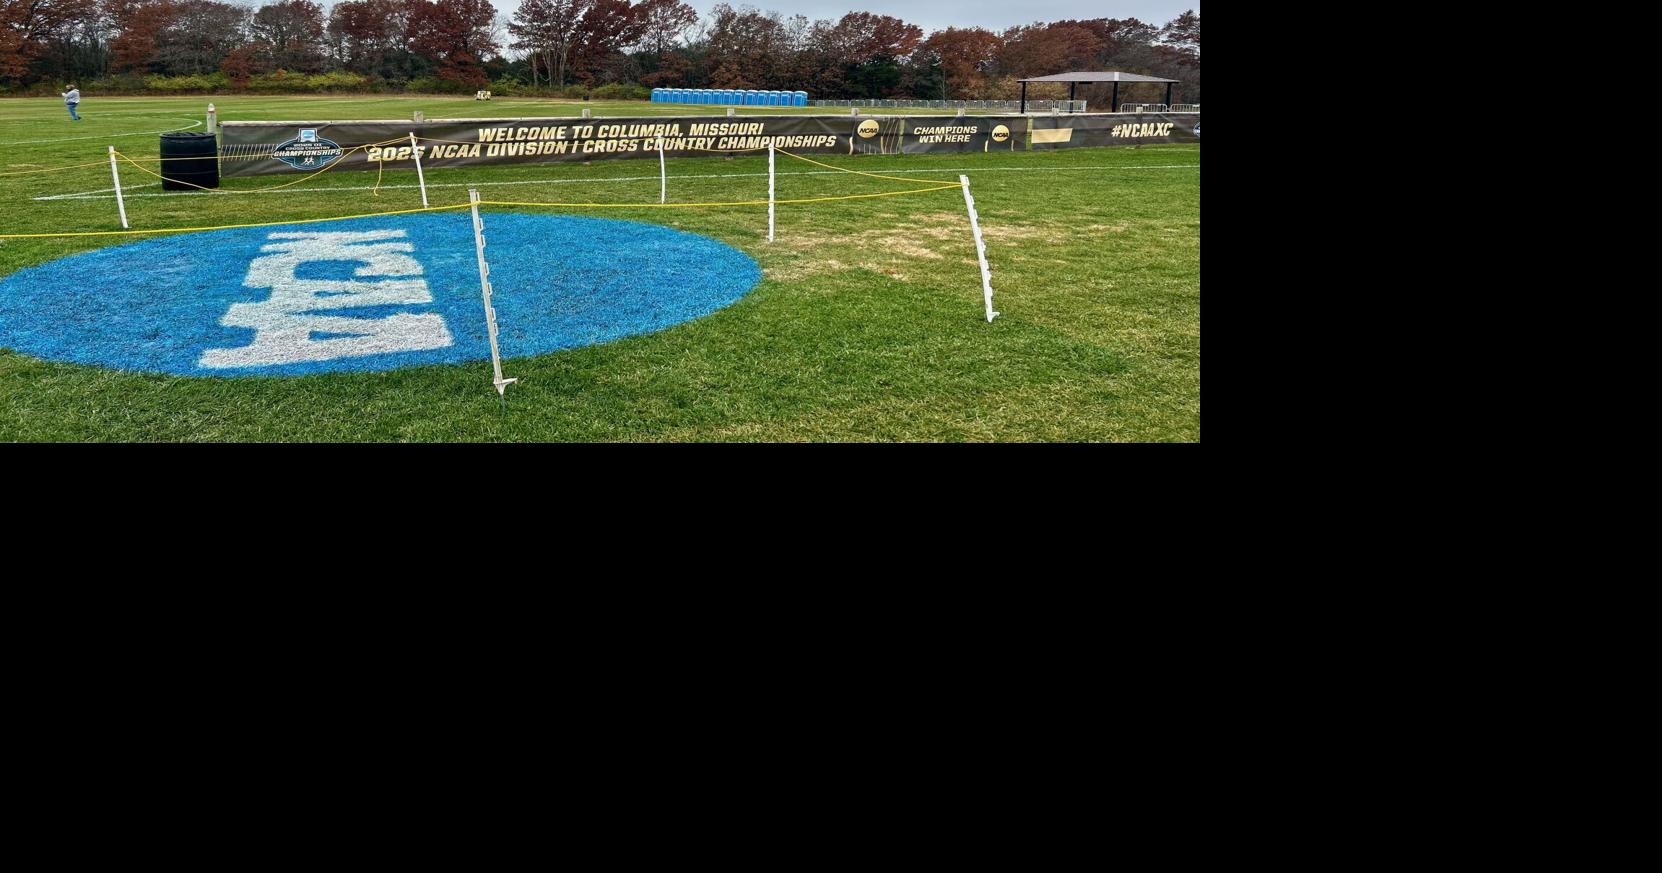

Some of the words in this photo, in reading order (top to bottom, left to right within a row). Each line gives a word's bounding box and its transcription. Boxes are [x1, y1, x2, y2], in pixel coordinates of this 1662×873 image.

[478, 126, 567, 142] WELCOME
[572, 125, 593, 139] TO
[597, 123, 683, 138] COLUMBIA,
[689, 122, 764, 136] MISSOURI
[913, 126, 978, 135] CHAMPIONS
[1111, 122, 1174, 138] #NCAAXC
[919, 135, 943, 144] WIN
[944, 134, 971, 143] HERE
[273, 149, 342, 157] CHAMPIONSHIPS
[367, 146, 425, 162] 2025
[429, 144, 481, 159] NCAA
[486, 141, 568, 157] DIVISION
[571, 140, 579, 154] I
[582, 139, 639, 153] CROSS
[643, 136, 716, 151] COUNTRY
[717, 135, 837, 150] CHAMPIONSHIPS
[198, 229, 454, 369] NCAA
